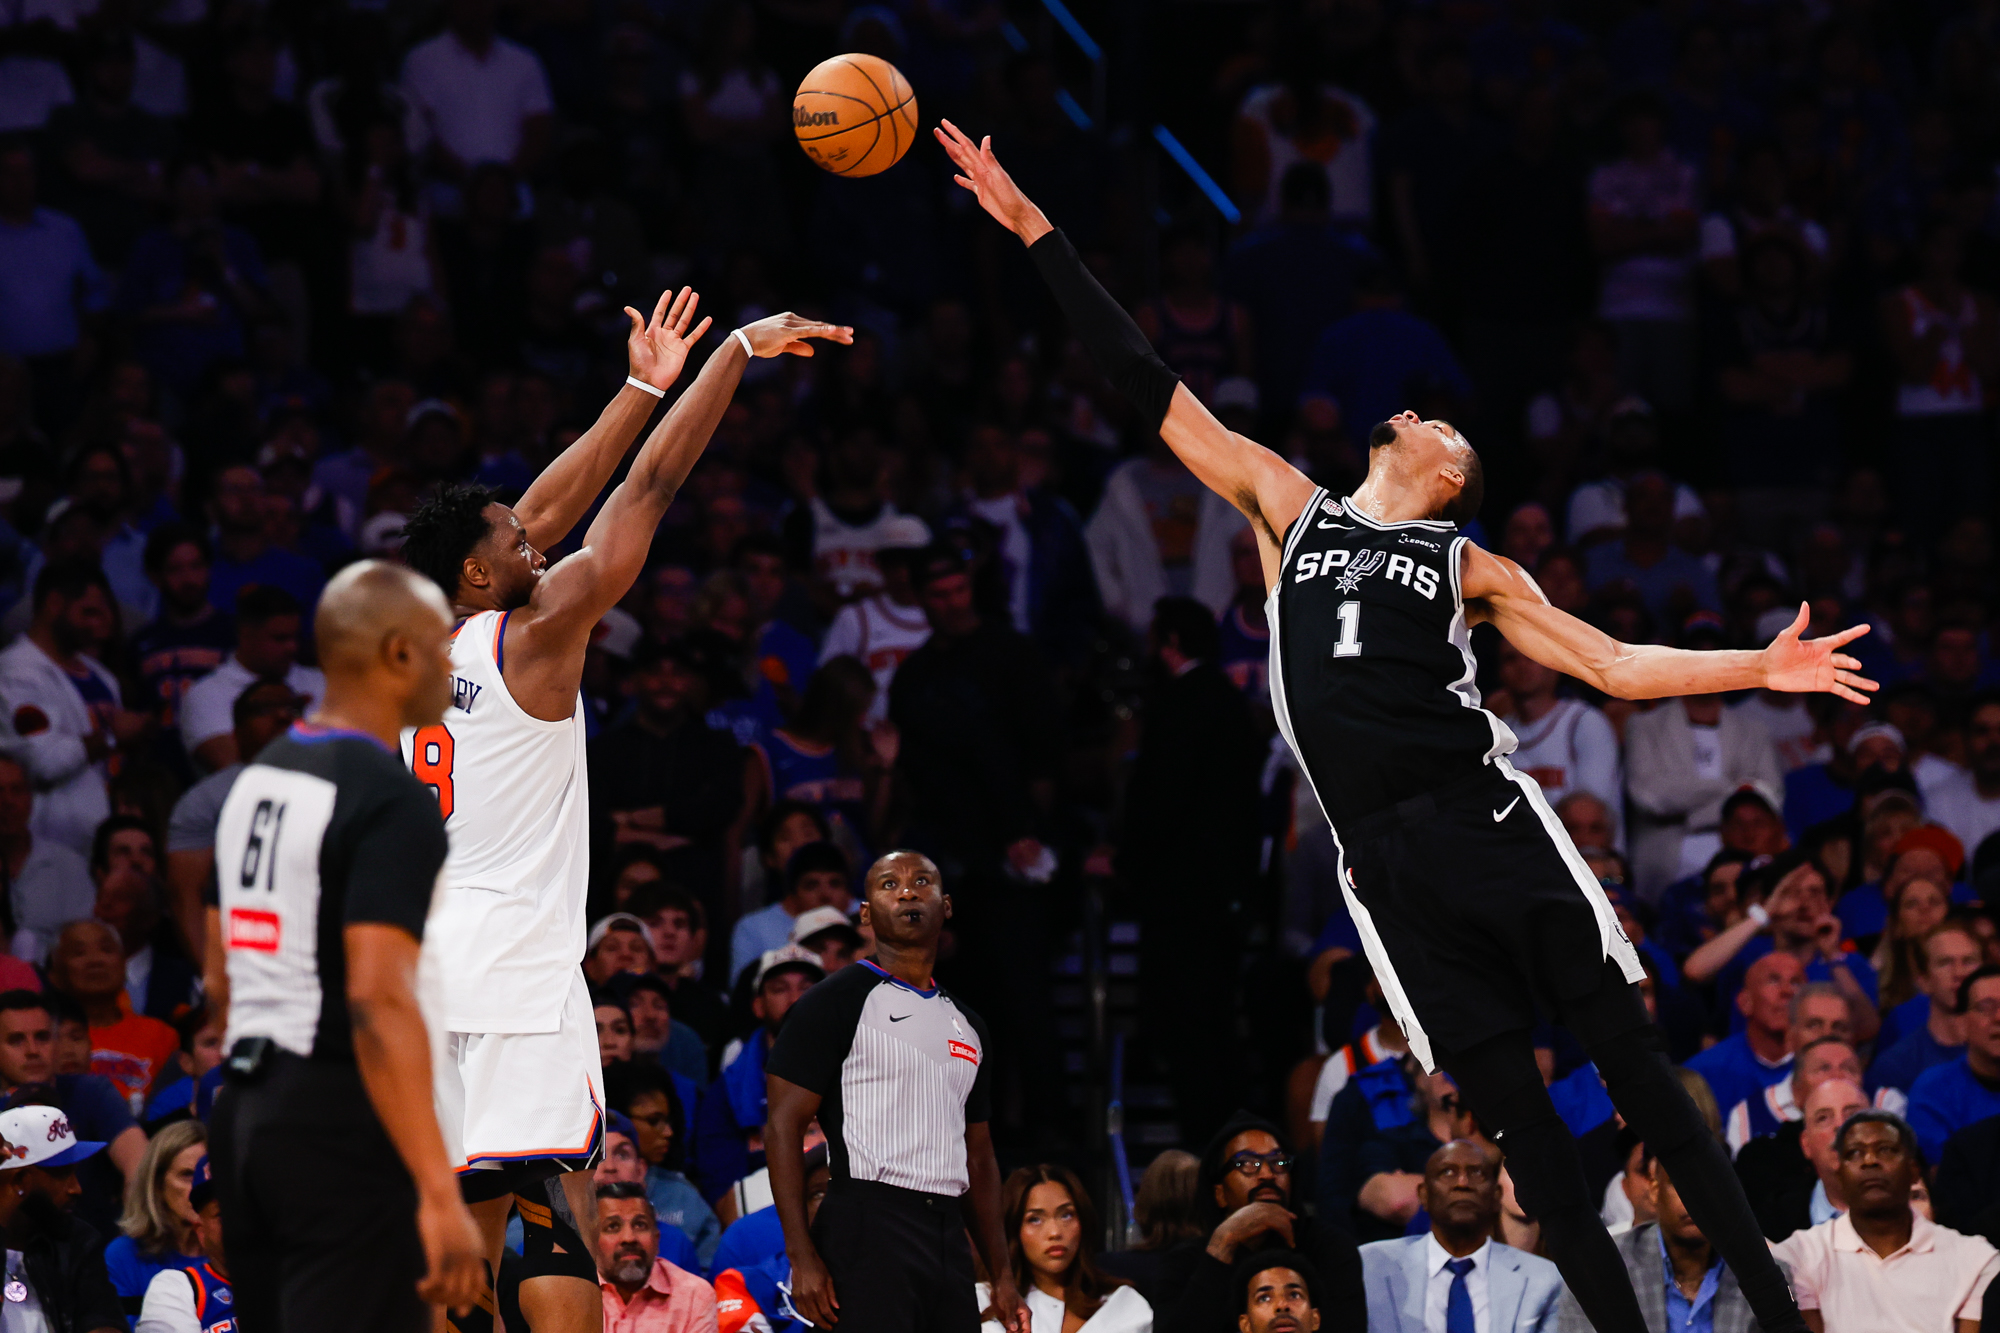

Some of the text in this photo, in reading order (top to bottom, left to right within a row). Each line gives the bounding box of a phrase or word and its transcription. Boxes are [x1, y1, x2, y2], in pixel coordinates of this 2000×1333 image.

[793, 105, 839, 127] ilson
[1402, 536, 1438, 551] LEDGER
[1294, 548, 1440, 600] SPURS
[1332, 600, 1362, 658] 1
[450, 674, 482, 714] BY
[412, 721, 455, 824] 8
[241, 799, 286, 892] 61
